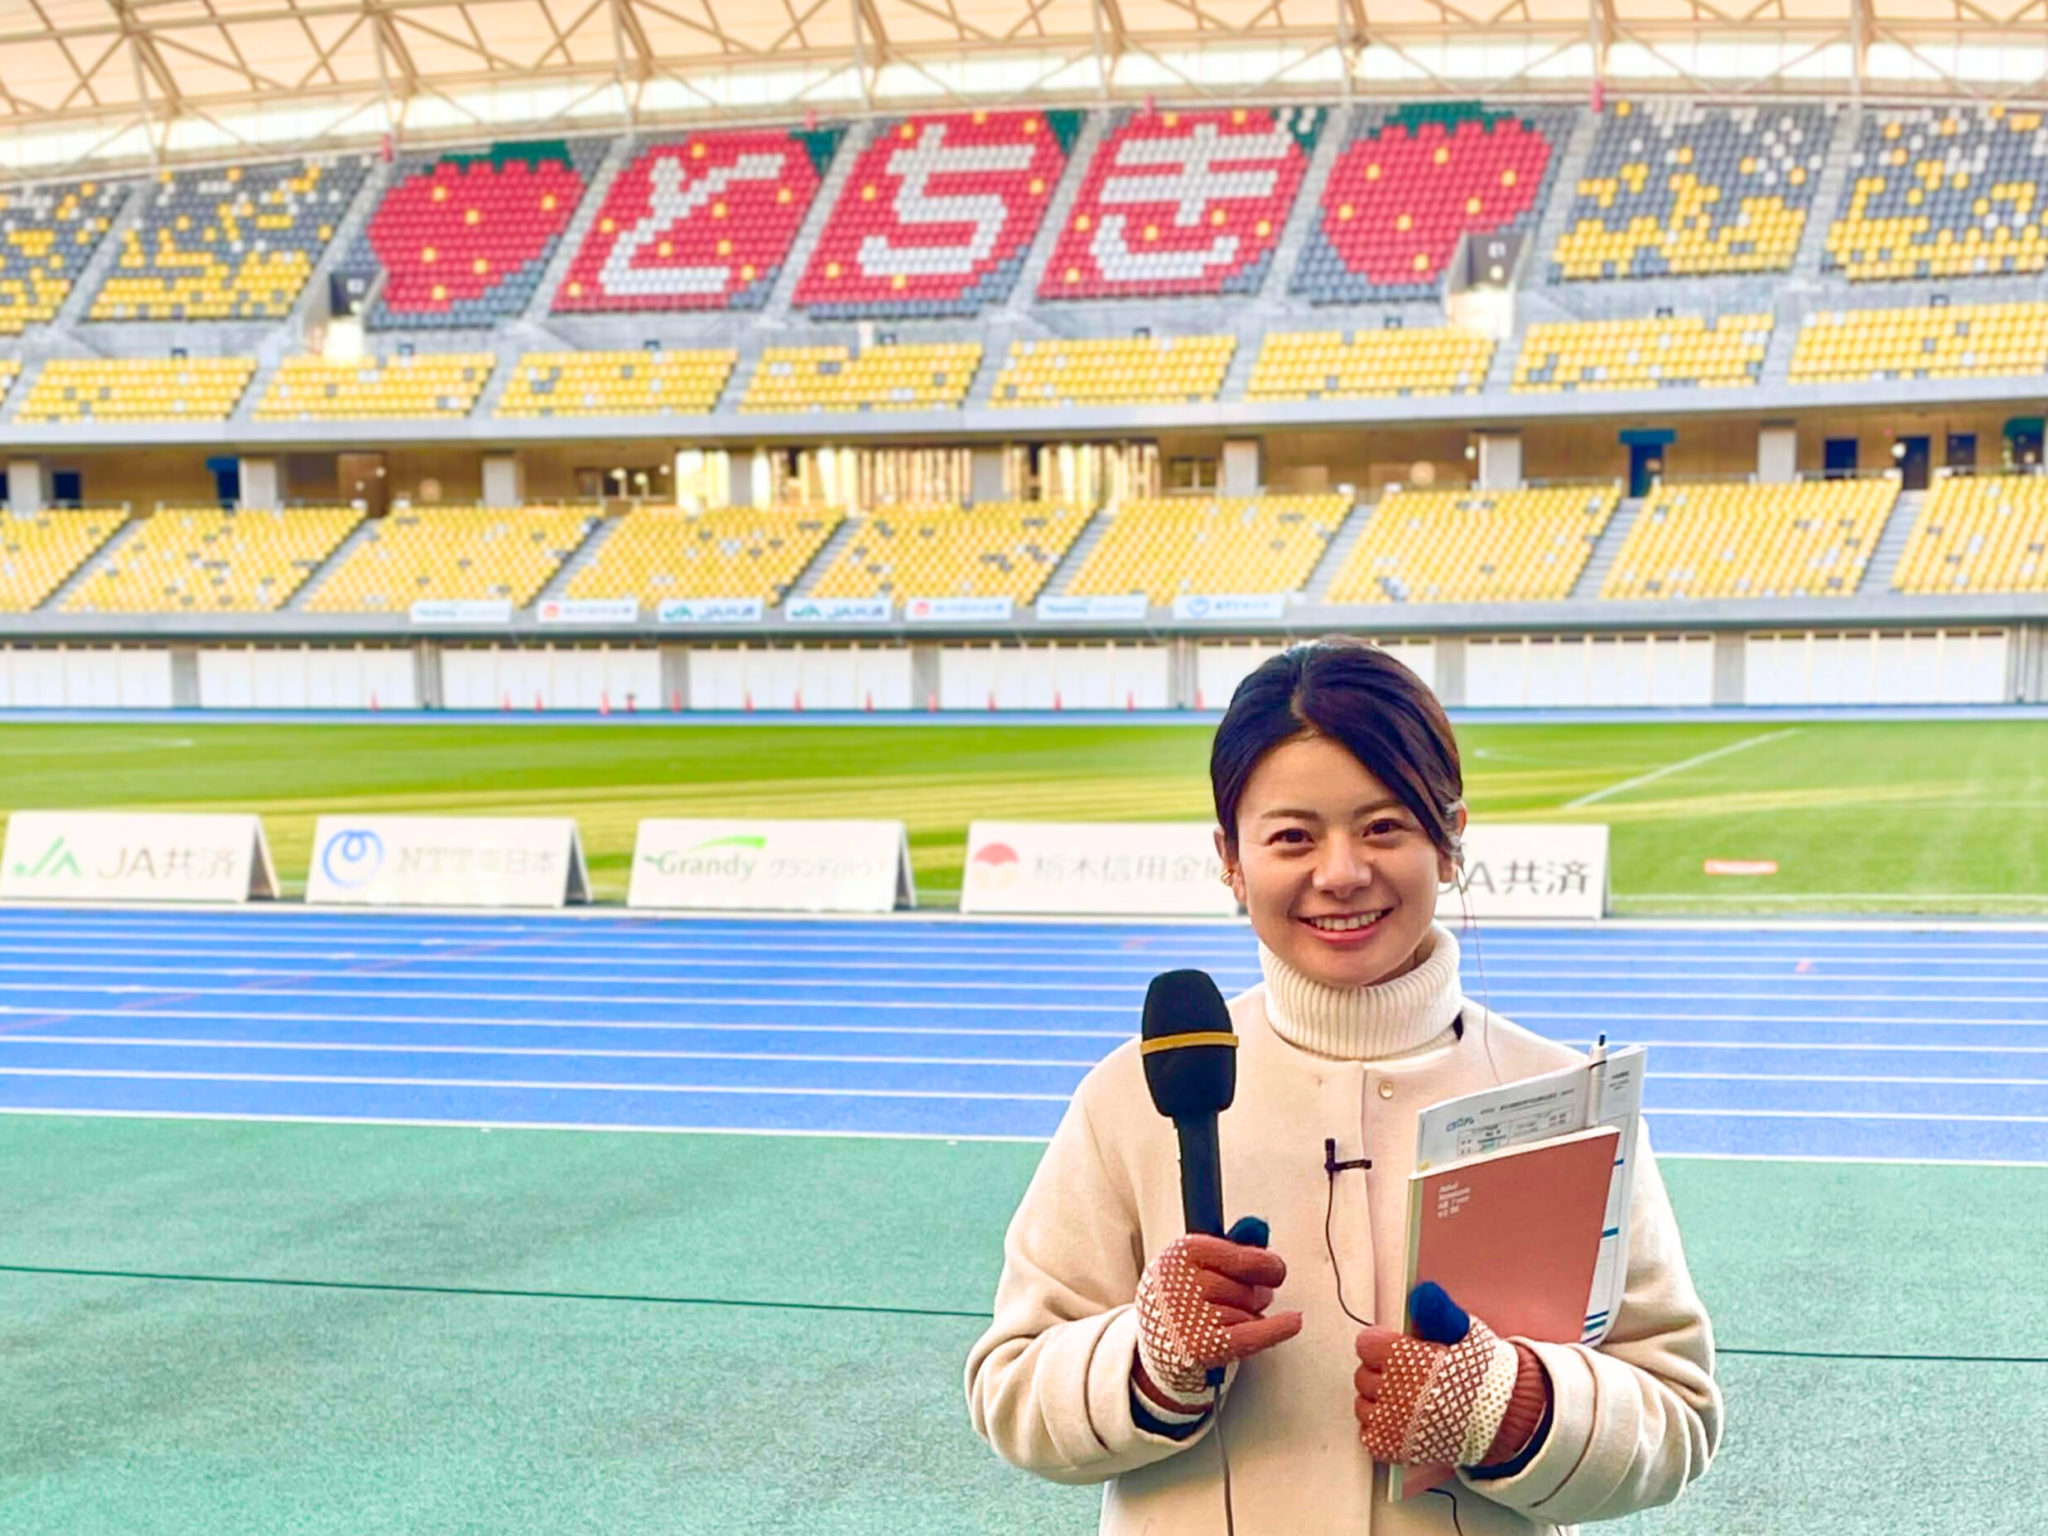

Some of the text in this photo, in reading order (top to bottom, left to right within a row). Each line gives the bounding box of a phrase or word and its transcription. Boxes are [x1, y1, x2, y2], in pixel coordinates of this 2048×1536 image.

[600, 108, 1320, 296] とちぎ
[97, 845, 240, 879] JA共済
[656, 850, 757, 882] Grandy
